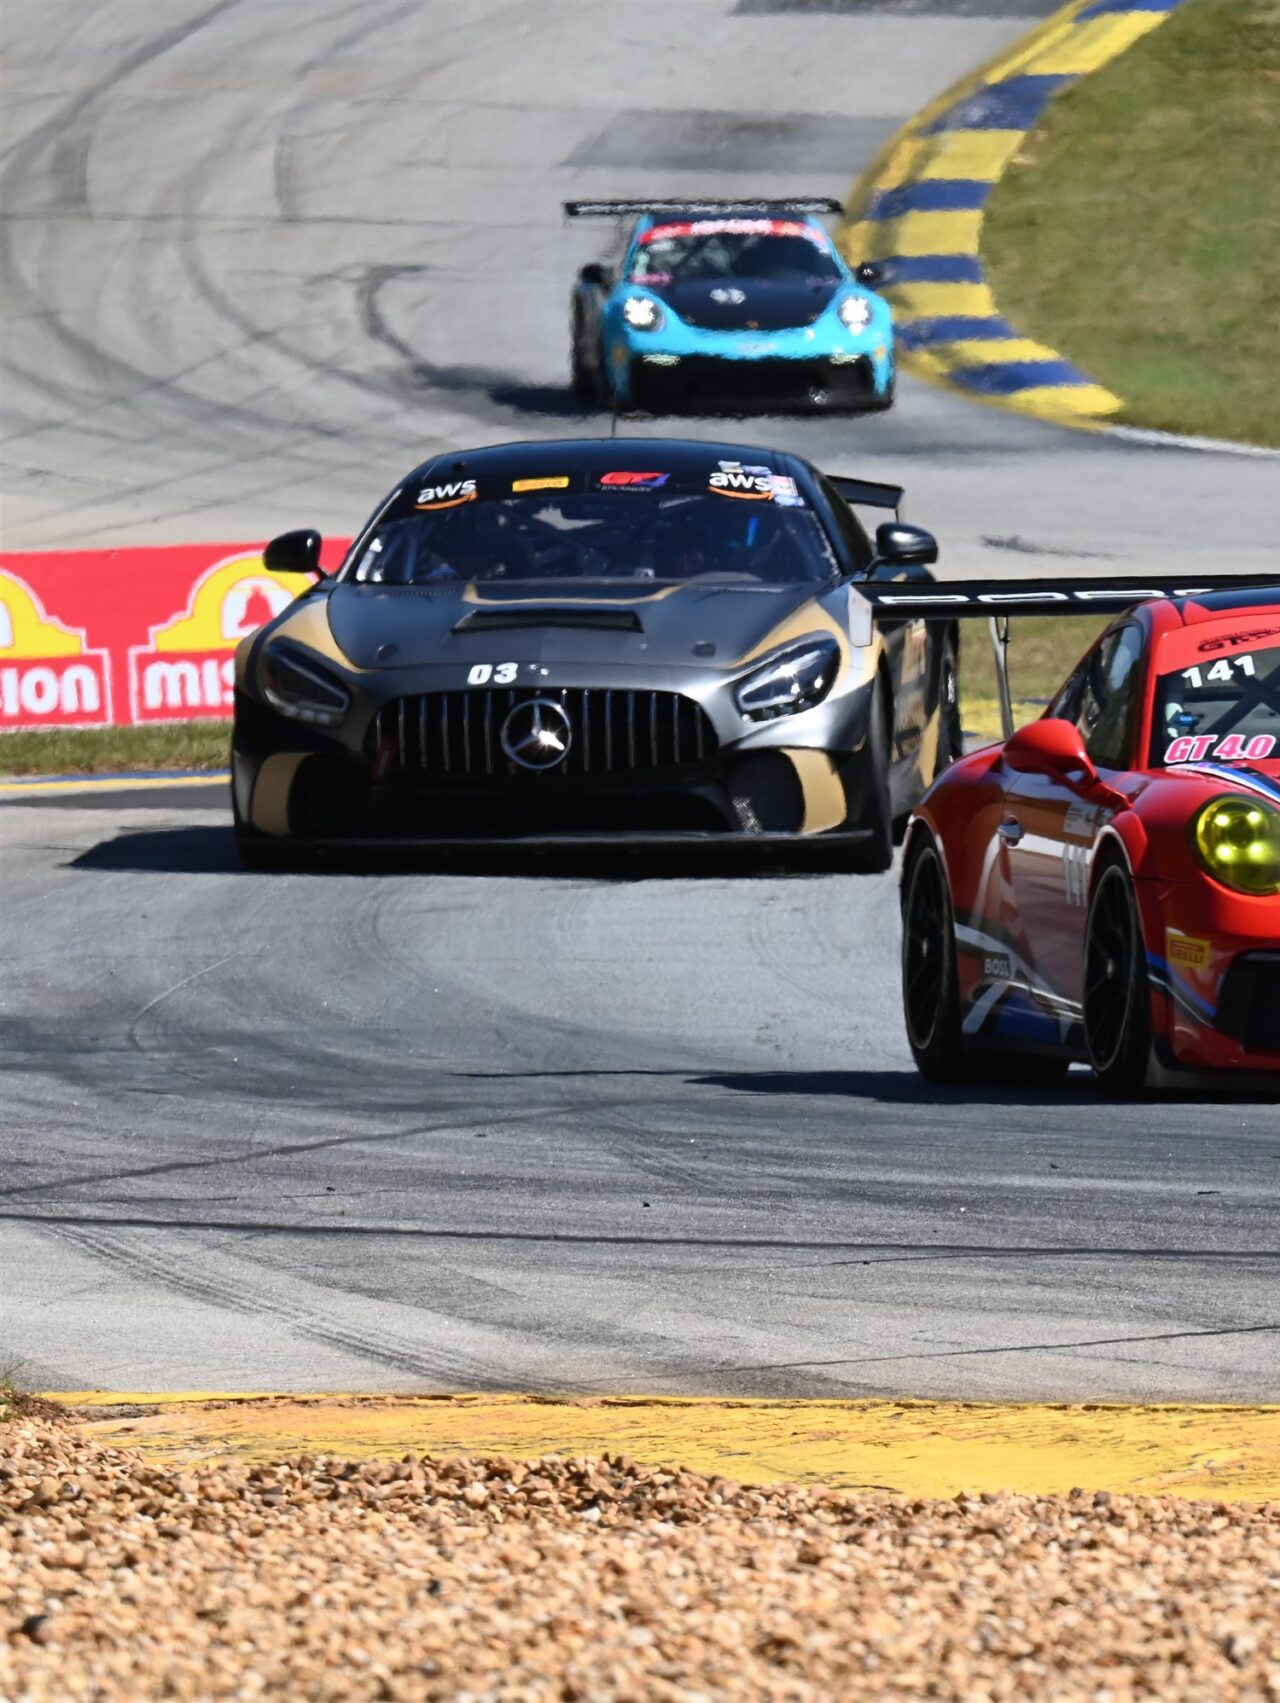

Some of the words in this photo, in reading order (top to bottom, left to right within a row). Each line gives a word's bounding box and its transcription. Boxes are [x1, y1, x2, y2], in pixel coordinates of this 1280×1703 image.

[417, 480, 477, 503] aws
[709, 472, 771, 491] aws
[467, 662, 519, 685] 03
[1181, 655, 1255, 688] 141
[1164, 735, 1218, 763] GT
[1212, 734, 1277, 760] 4.0
